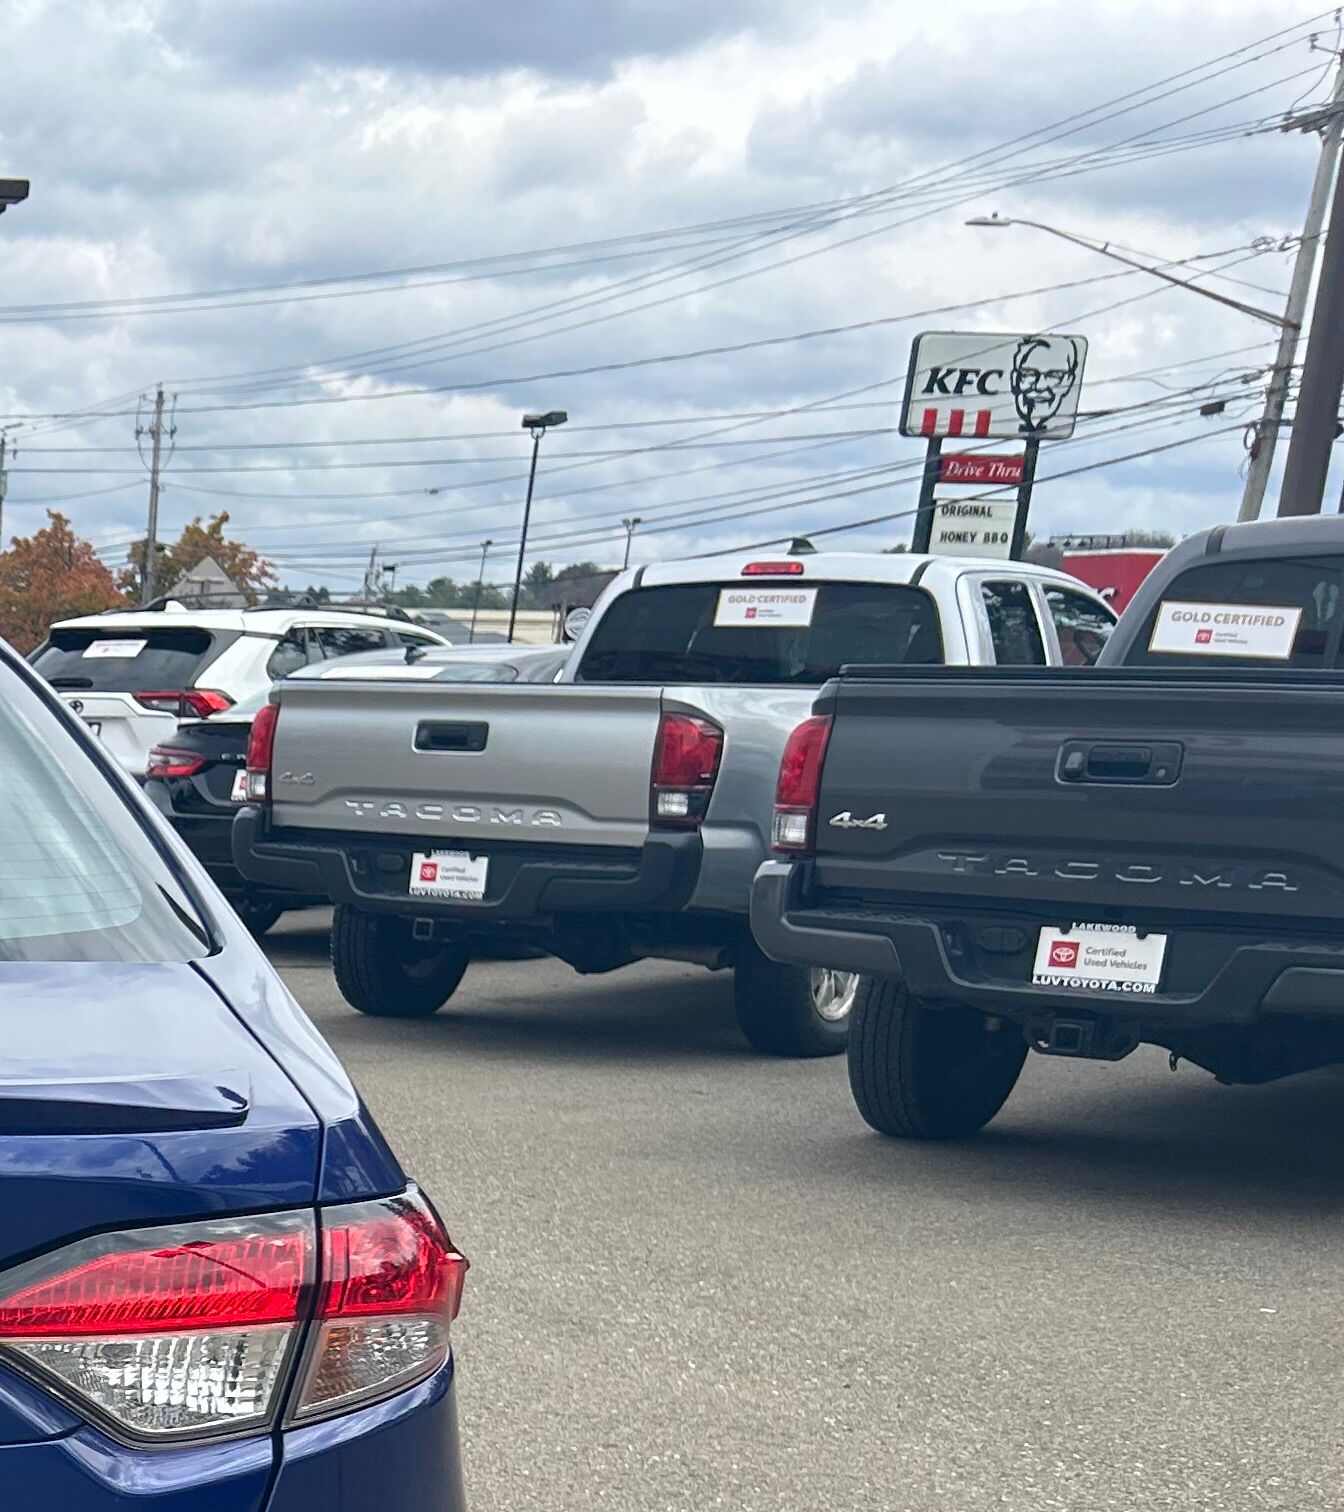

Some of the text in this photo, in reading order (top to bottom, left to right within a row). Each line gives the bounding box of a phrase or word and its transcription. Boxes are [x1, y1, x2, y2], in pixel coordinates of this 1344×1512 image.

[921, 366, 1004, 395] KFC
[945, 460, 1021, 477] Drive Thru
[940, 504, 993, 518] ORIGINAL
[939, 531, 1009, 544] HONEY BBQ
[728, 594, 807, 604] GOLD CERTIFIED
[1171, 610, 1286, 627] GOLD CERTIFIED
[345, 800, 563, 826] TACOMA
[829, 811, 888, 830] 4x4
[937, 852, 1299, 891] TACOMA
[1072, 922, 1137, 933] LAKEWOOD
[1085, 947, 1126, 957] Certified
[1084, 958, 1147, 970] Used Vehicles
[1032, 975, 1155, 993] LUVTOYOTA.COM
